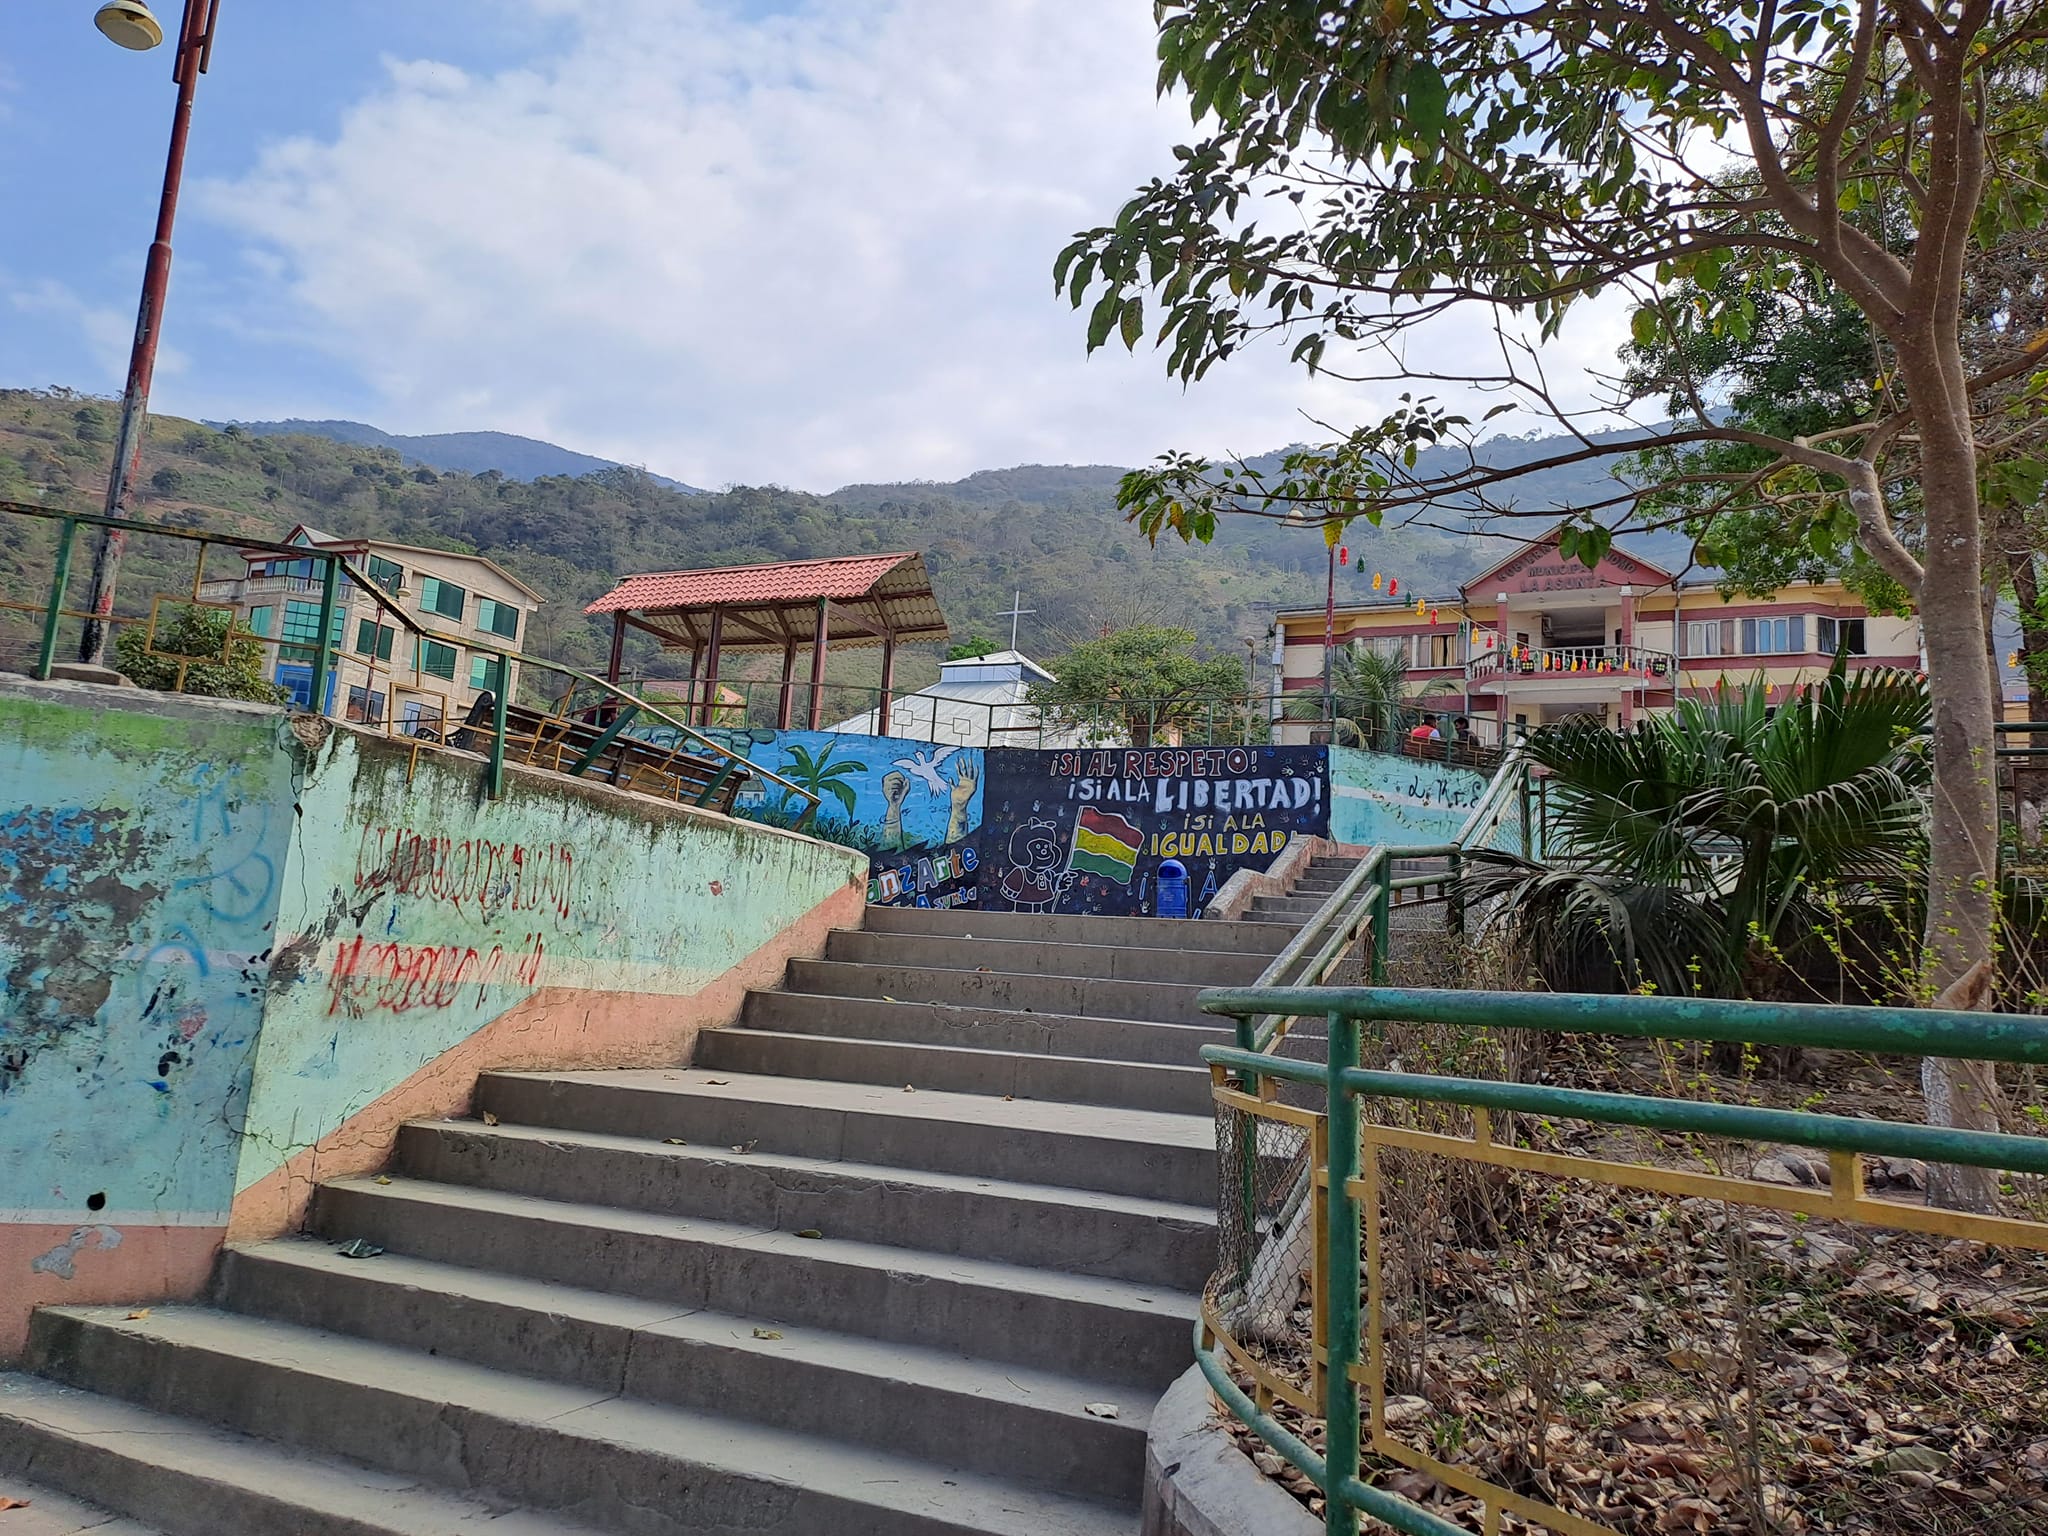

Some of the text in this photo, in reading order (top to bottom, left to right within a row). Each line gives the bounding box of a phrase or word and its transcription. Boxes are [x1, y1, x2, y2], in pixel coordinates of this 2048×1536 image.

[1497, 544, 1555, 582] GOBIERN
[1528, 563, 1593, 577] MUNICIPA
[1520, 574, 1608, 593] LA ASUNTA
[1087, 750, 1117, 777] AL
[1123, 749, 1257, 780] RESPETO!
[1155, 777, 1321, 815] LIBERTAD!
